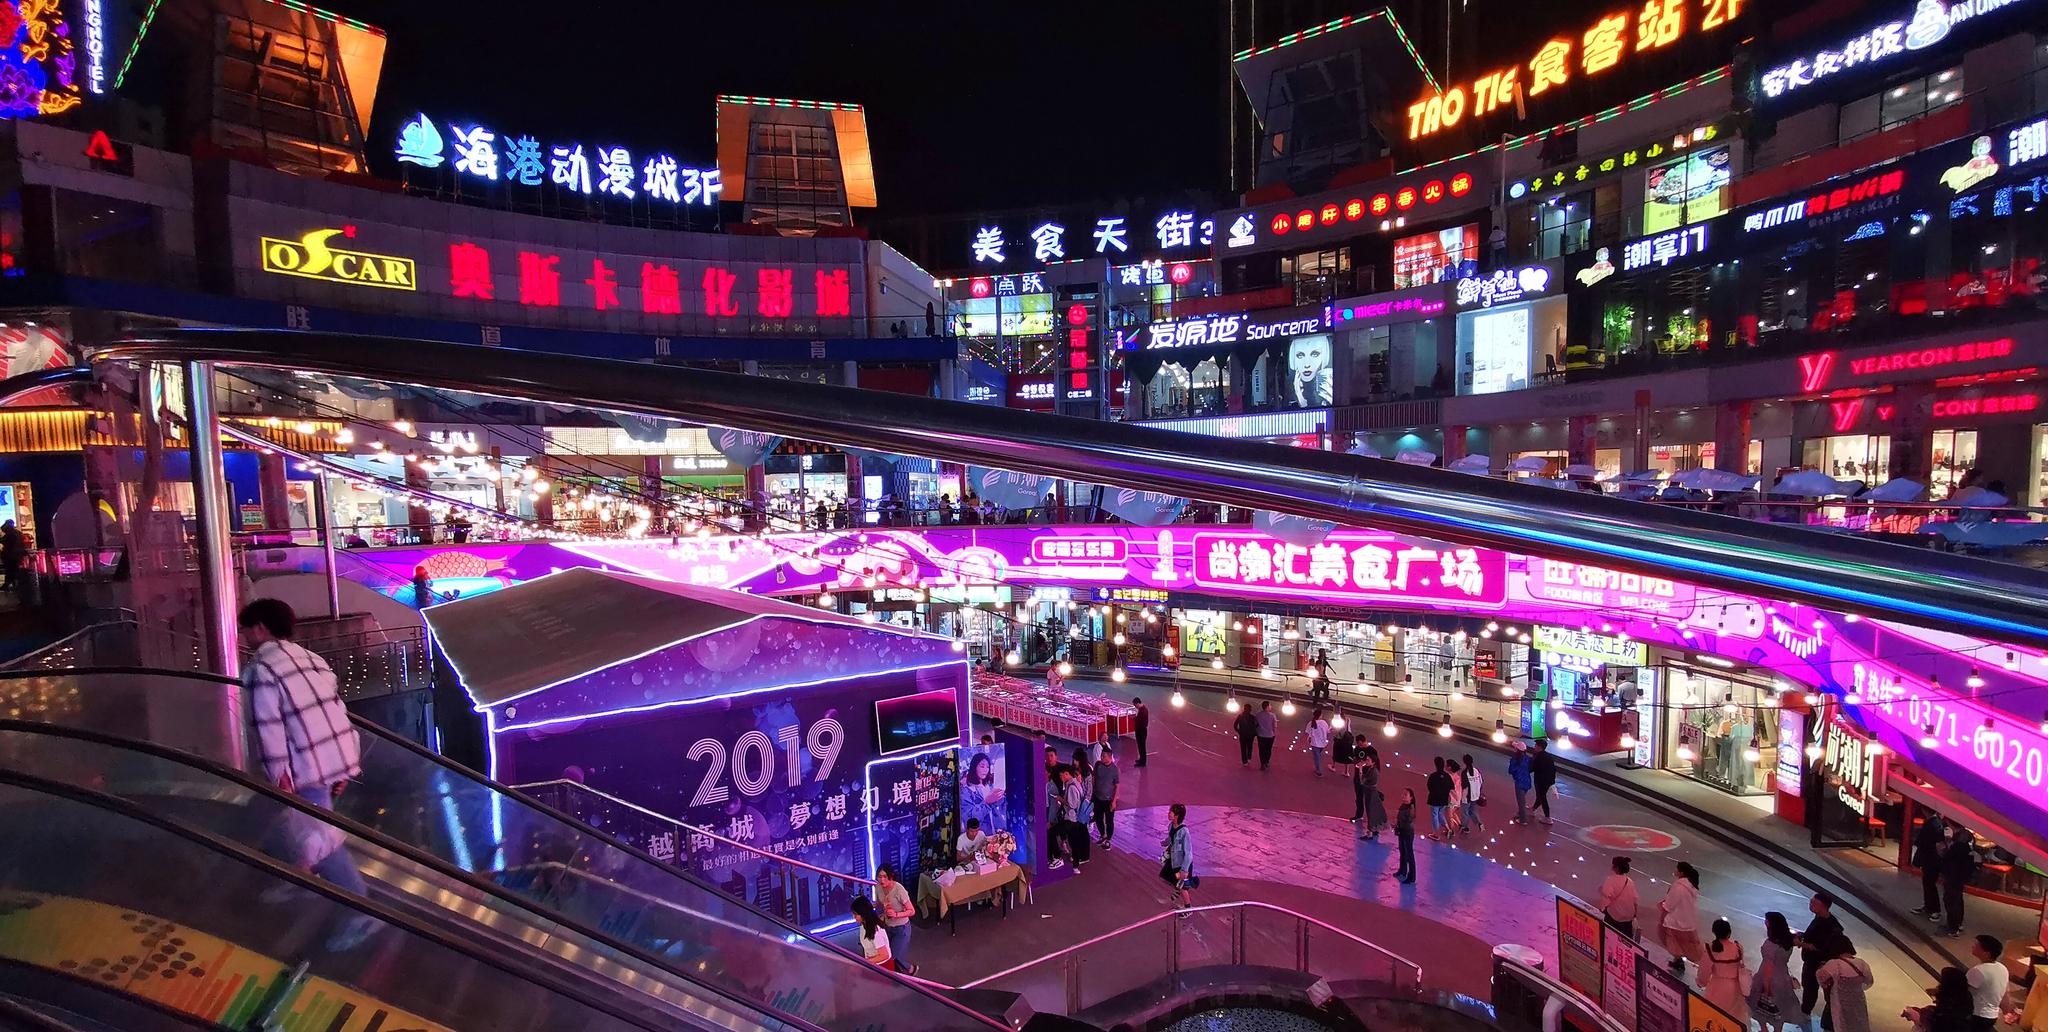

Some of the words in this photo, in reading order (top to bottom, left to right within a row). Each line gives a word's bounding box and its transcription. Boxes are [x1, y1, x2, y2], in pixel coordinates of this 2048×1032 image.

[1529, 0, 1685, 97] 食客站
[1408, 88, 1465, 140] TAO
[1474, 67, 1517, 117] TIE
[452, 122, 723, 205] 海港动漫城3F
[268, 228, 412, 286] OSCAR
[450, 242, 851, 318] 奥斯卡德化影城
[1624, 225, 1707, 270] 潮掌门
[1246, 318, 1320, 341] Sourceme
[1851, 347, 1954, 376] YEARCON
[686, 717, 845, 808] 2019
